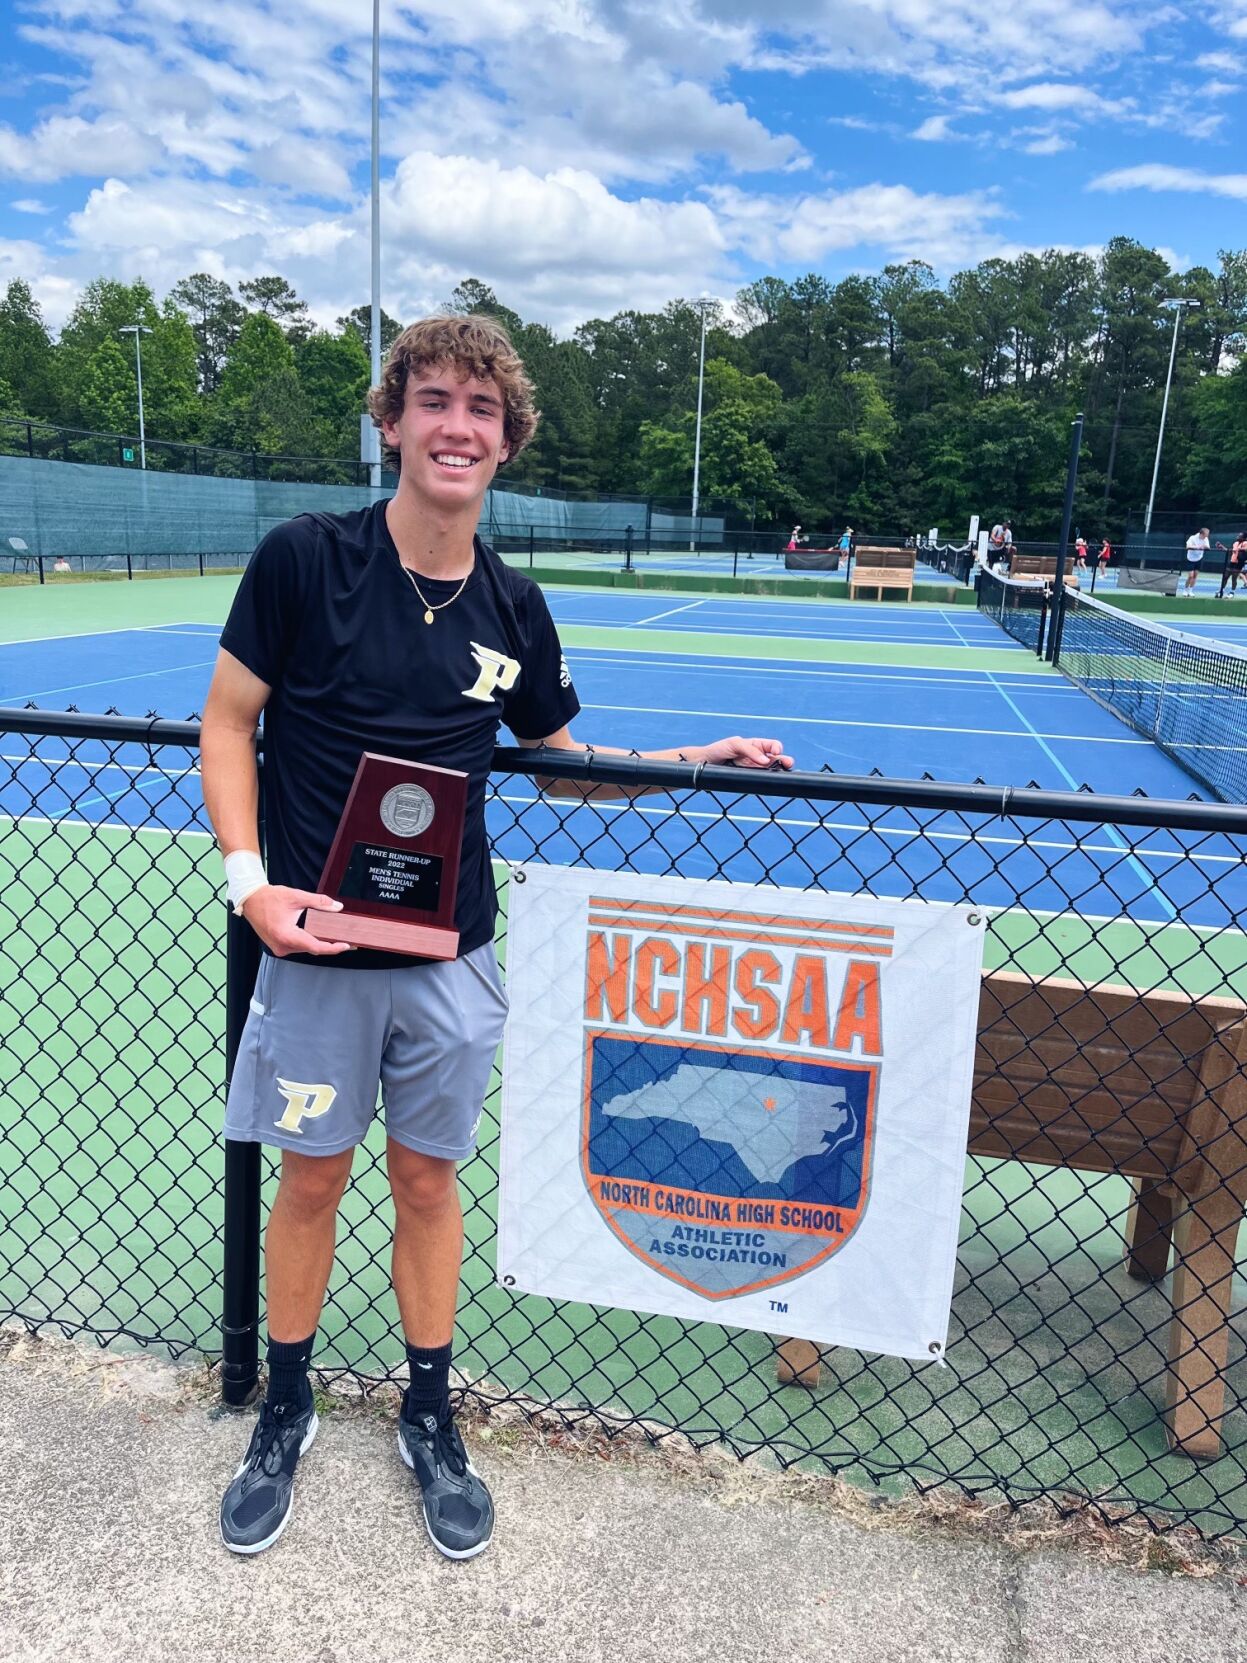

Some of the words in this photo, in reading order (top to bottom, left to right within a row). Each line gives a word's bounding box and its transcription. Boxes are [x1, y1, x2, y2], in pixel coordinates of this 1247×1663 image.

[461, 641, 521, 702] P
[365, 848, 388, 858] STATE
[388, 852, 431, 865] RUNNER-UP
[387, 860, 405, 868] 2022
[368, 866, 391, 876] MEN'S
[392, 870, 420, 881] TENNIS
[371, 874, 414, 887] INDIVIDUAL
[378, 882, 405, 892] SINGLES
[379, 891, 400, 900] AAAA
[584, 930, 883, 1056] NCHSAA
[273, 1077, 337, 1134] P
[600, 1181, 649, 1207] NORTH
[655, 1190, 731, 1222] CAROLINA
[737, 1203, 775, 1224] HIGH
[780, 1206, 844, 1233] SCHOOL
[671, 1224, 766, 1247] ATHLETIC
[649, 1239, 787, 1268] ASSOCIATION
[768, 1300, 788, 1313] TM
